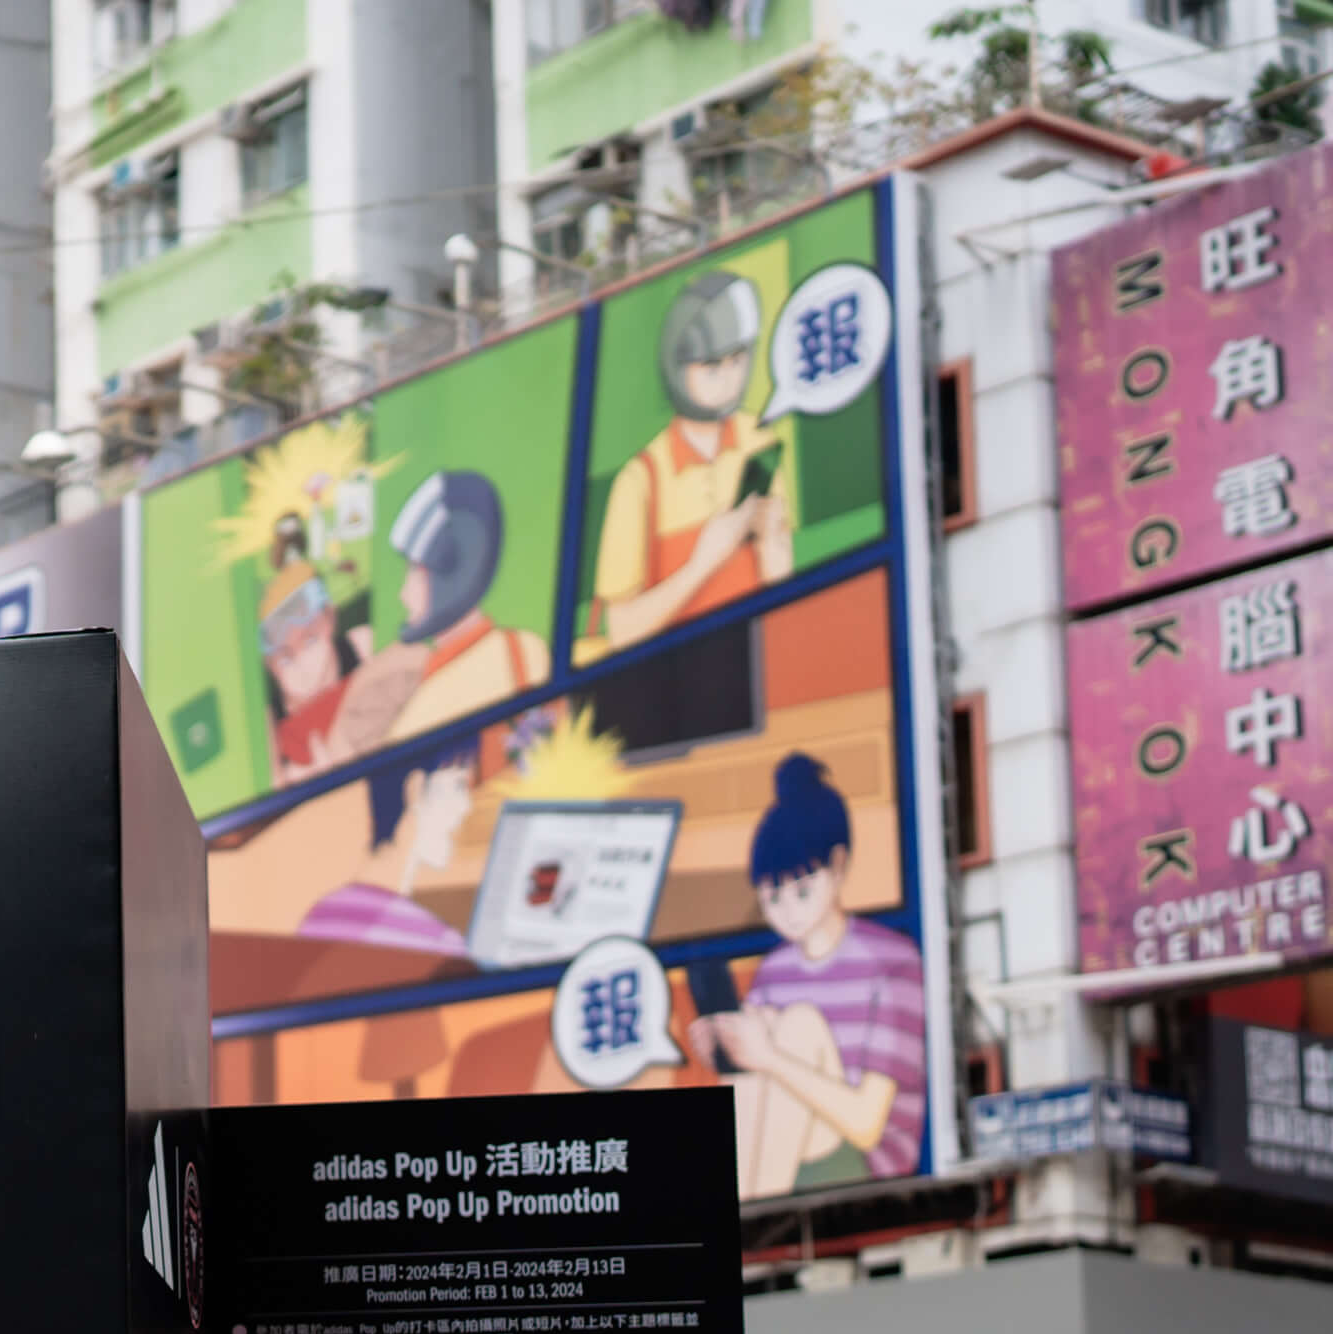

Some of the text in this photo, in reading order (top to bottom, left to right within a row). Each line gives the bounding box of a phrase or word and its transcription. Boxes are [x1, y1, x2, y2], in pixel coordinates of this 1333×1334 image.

[798, 291, 859, 382] 報
[1200, 206, 1313, 863] 旺角電腦中心
[1133, 870, 1324, 937] COMPUTER
[1134, 903, 1326, 967] CENTRE
[582, 969, 641, 1054] 報
[313, 1138, 629, 1183] adidas Pop Up 活動推廣
[325, 1186, 620, 1223] adidas Pop Up Promotion
[367, 1282, 584, 1303] Promotion Period: FEB 1 to 13, 2024
